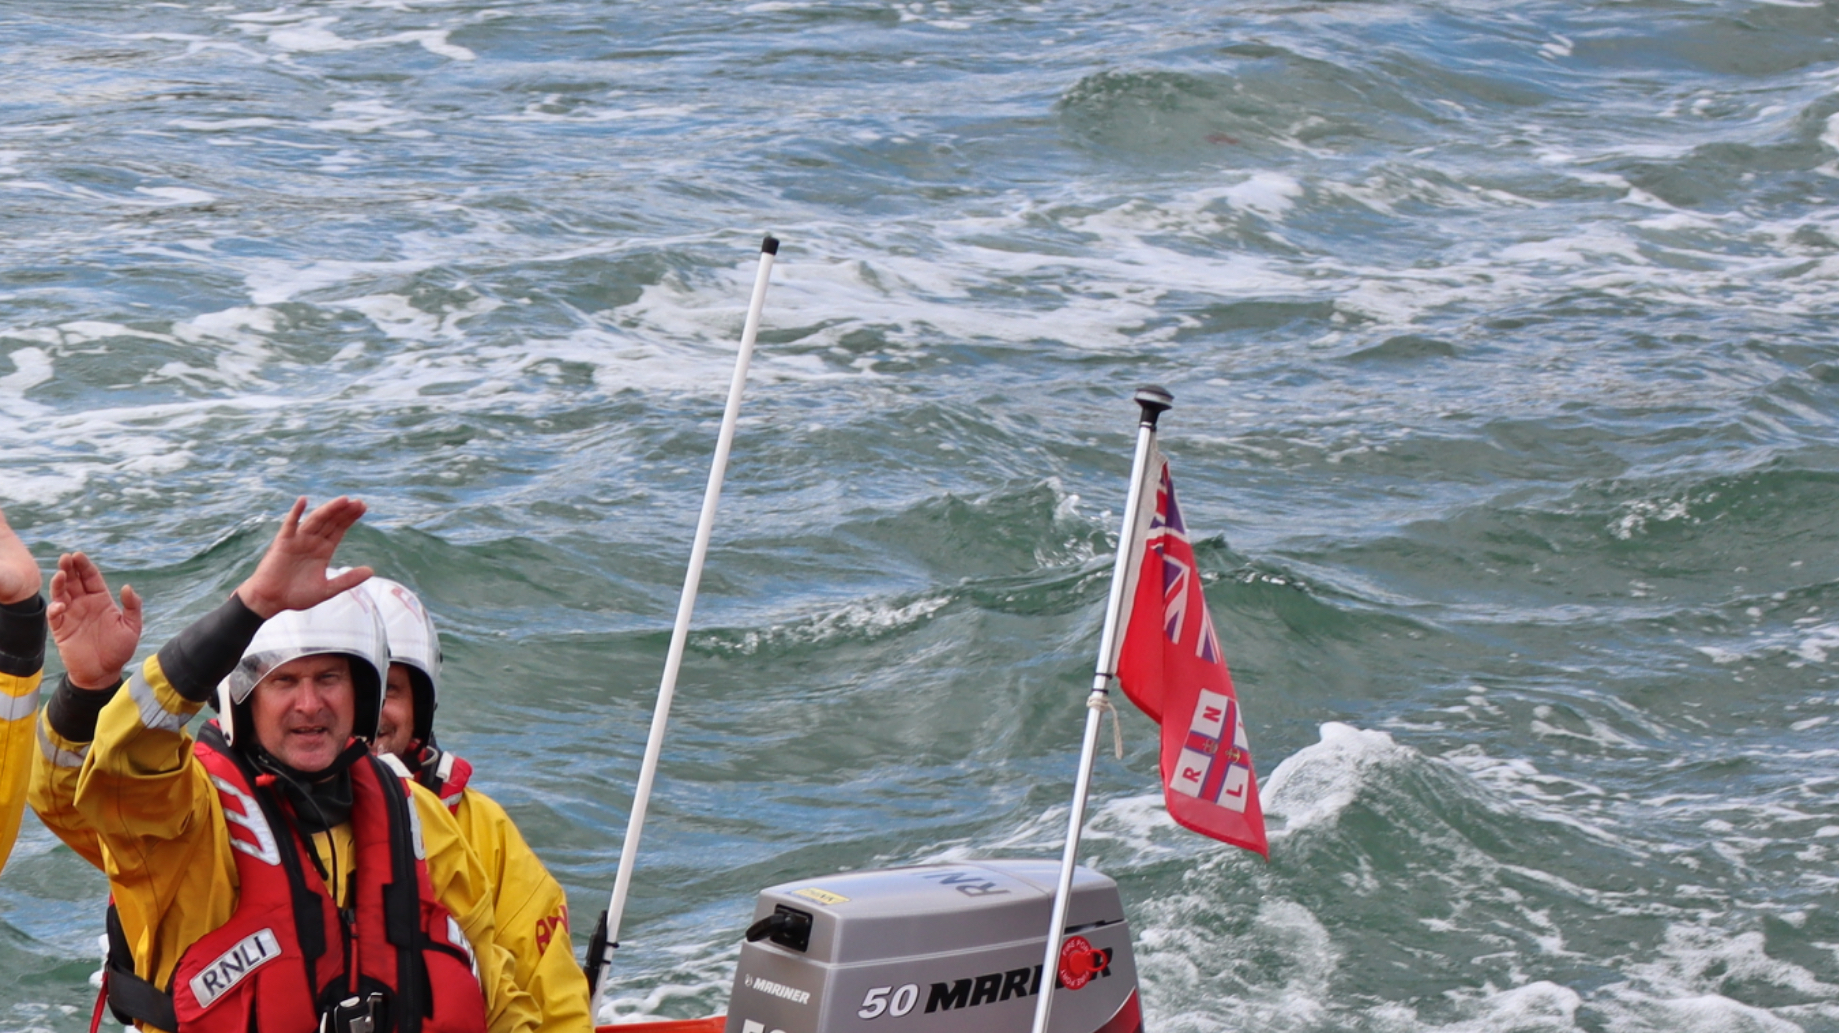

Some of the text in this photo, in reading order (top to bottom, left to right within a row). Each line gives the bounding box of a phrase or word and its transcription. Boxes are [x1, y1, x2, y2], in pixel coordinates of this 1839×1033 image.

[202, 936, 266, 996] RNLI
[753, 977, 811, 1004] MARINER
[858, 984, 920, 1019] 50
